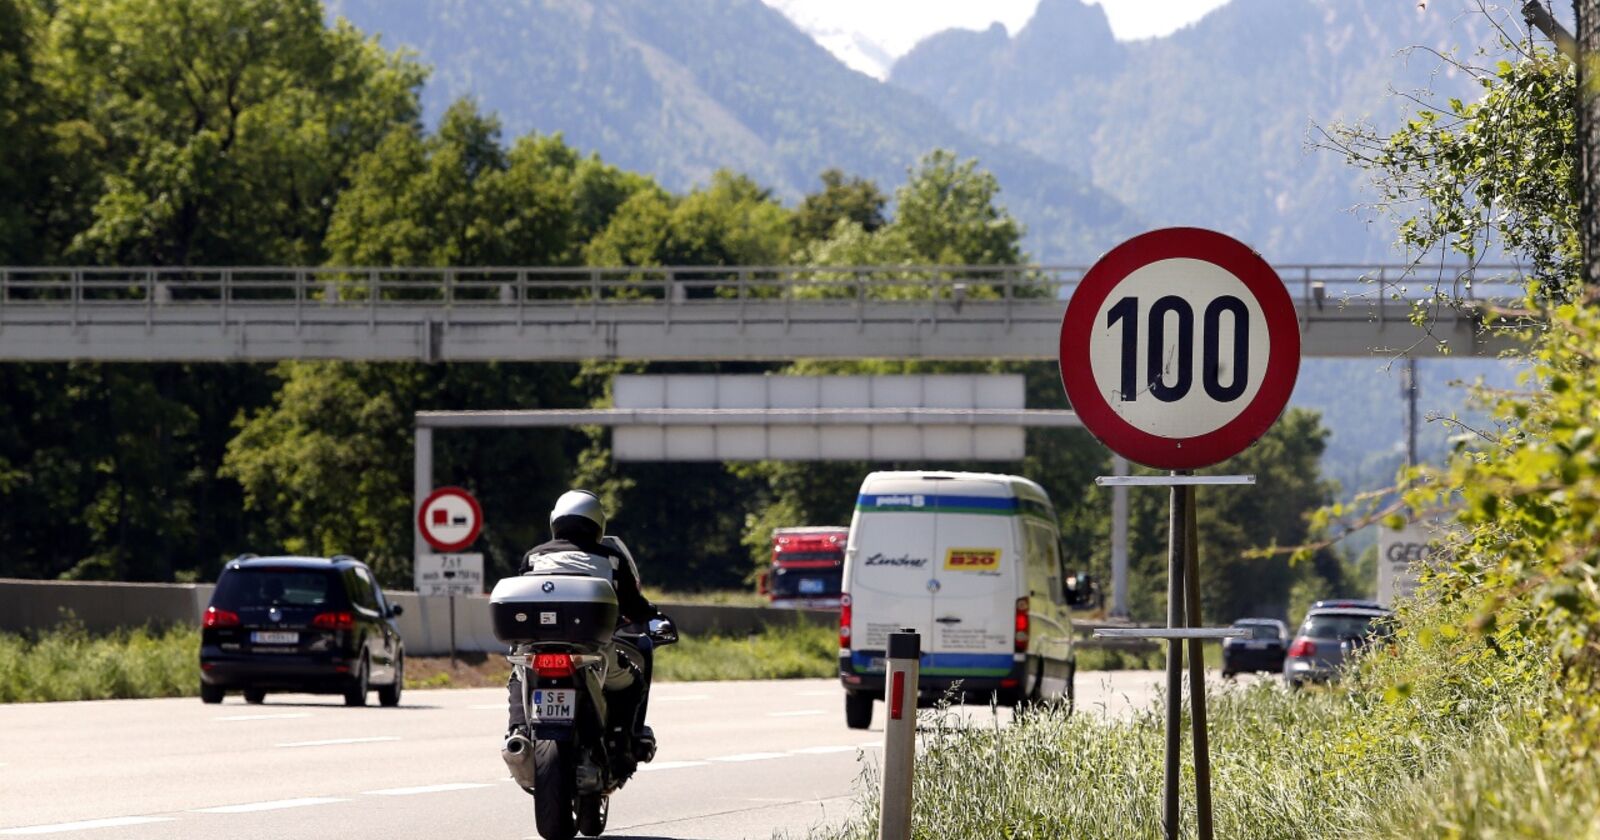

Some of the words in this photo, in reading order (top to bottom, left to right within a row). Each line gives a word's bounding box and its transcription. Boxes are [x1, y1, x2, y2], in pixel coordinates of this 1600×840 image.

[1107, 295, 1250, 403] 100
[547, 691, 554, 703] S
[536, 704, 542, 717] 4
[547, 704, 570, 717] DTM
